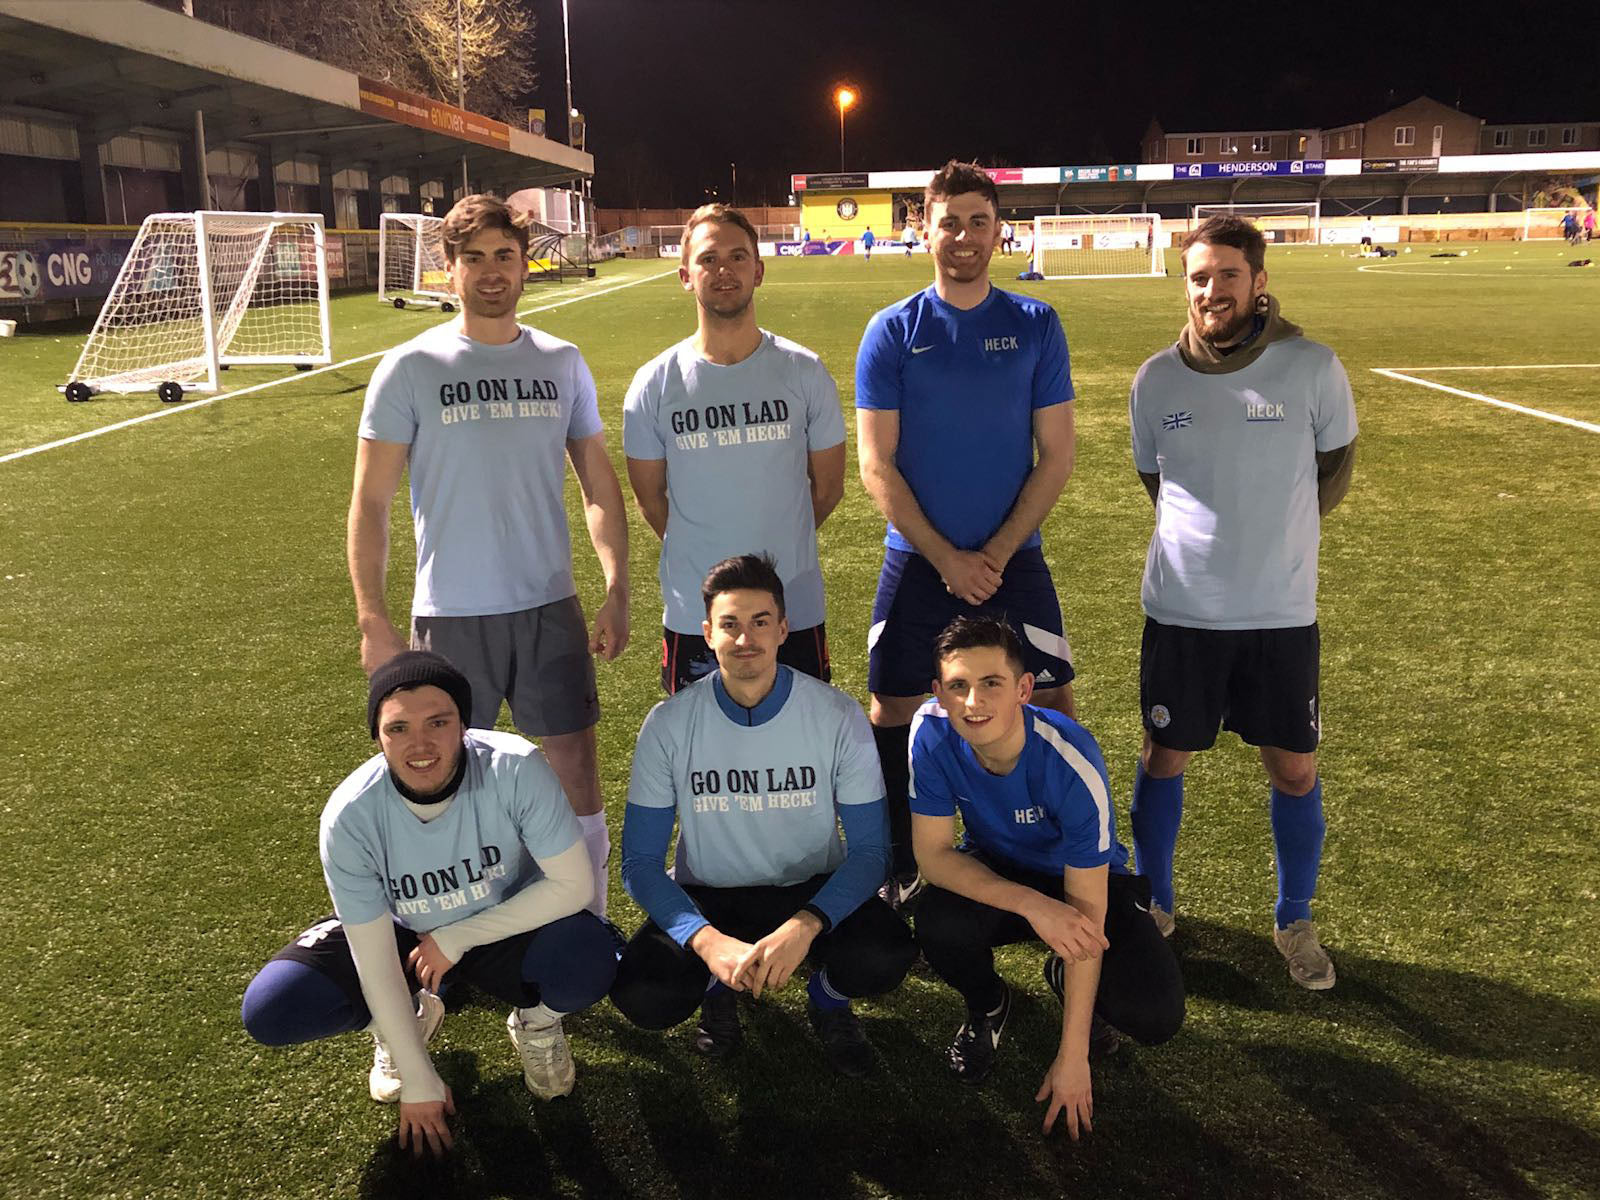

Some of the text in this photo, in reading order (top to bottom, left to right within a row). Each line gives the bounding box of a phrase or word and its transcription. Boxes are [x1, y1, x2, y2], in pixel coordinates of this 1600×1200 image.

[1219, 162, 1277, 172] HENDERSON
[48, 253, 91, 286] CNG
[984, 336, 1018, 351] HECK
[440, 379, 558, 406] GO ON LAD
[441, 402, 562, 425] GIVE 'EM HECK!
[671, 399, 789, 434] GO ON LAD
[1247, 404, 1284, 417] HECK
[676, 424, 791, 450] GIVE 'EM HECK!
[691, 766, 816, 796] GO ON LAD
[693, 791, 817, 813] GIVE 'EM HECK!
[389, 845, 501, 899] GO ON LD
[434, 890, 468, 911] 'EM
